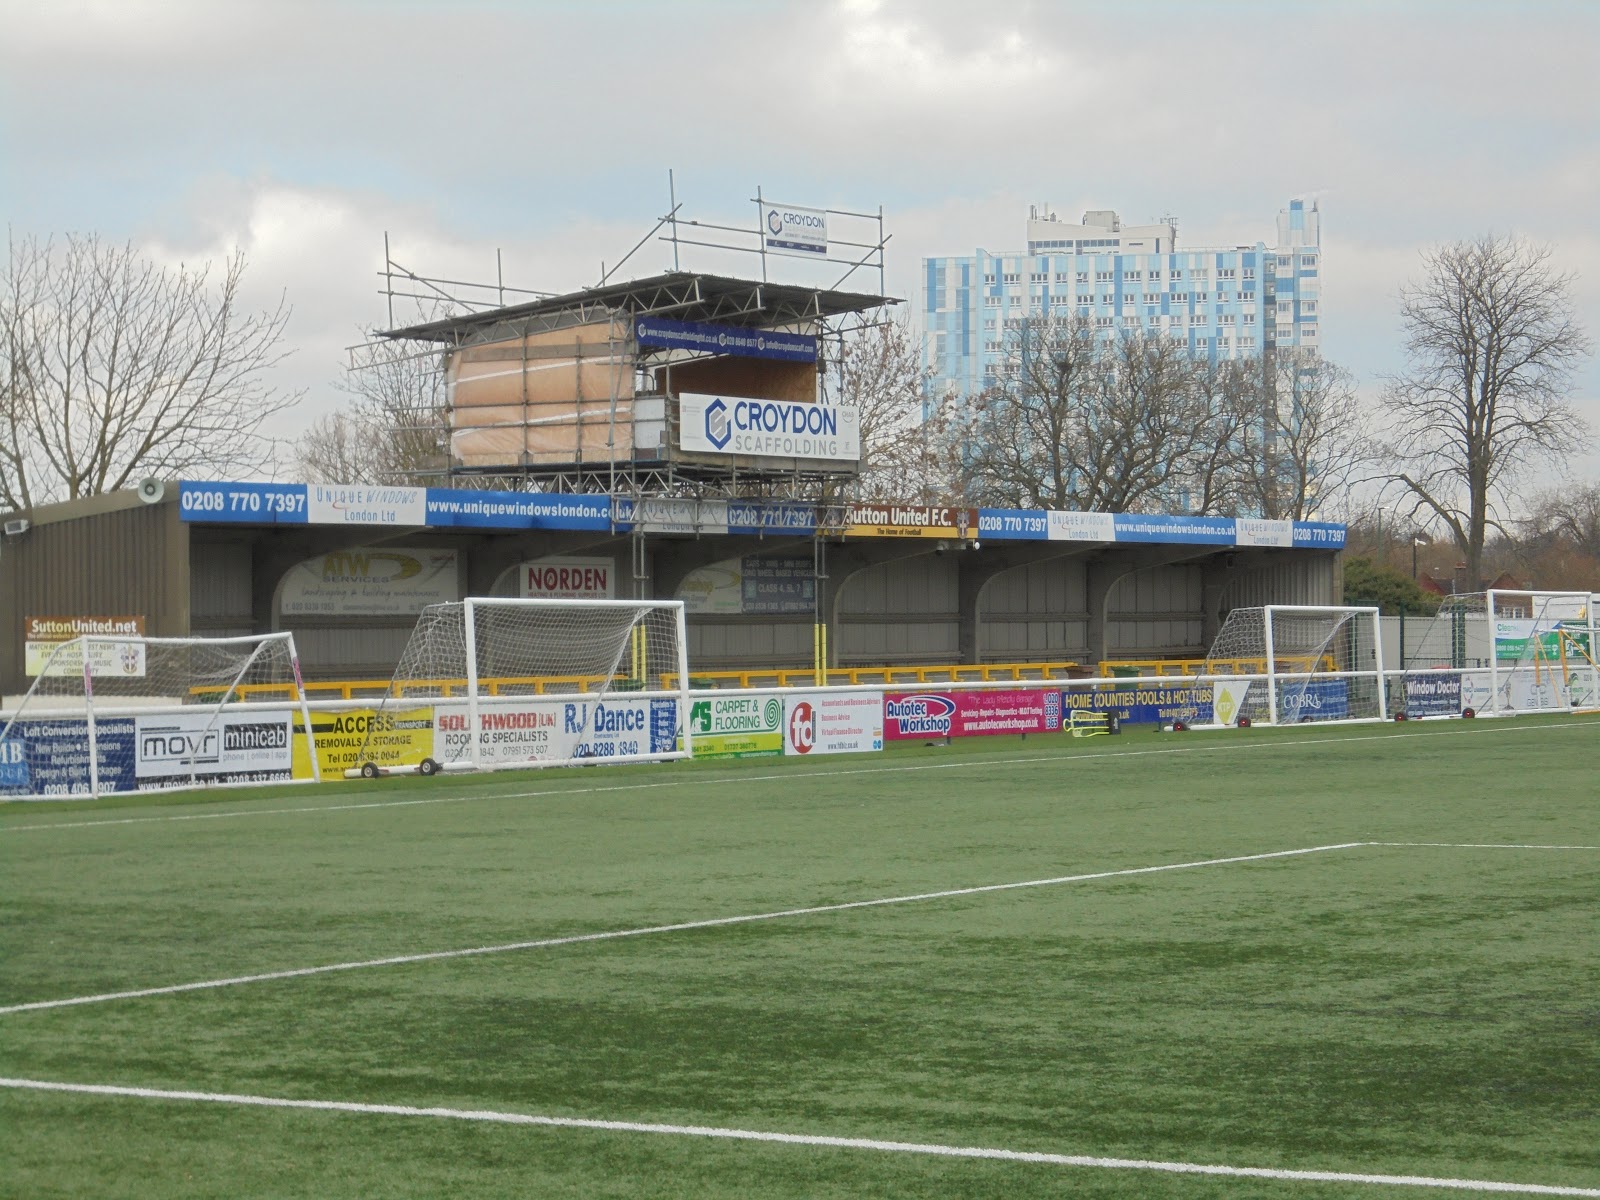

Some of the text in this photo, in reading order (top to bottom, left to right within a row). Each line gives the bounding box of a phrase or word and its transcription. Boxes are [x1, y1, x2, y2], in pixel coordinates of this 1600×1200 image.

[783, 213, 825, 229] CROYDON
[734, 400, 837, 436] CROYDON
[735, 434, 837, 456] SCAFFOLDING
[181, 491, 306, 513] 0208 770 7397
[316, 486, 418, 504] UNIQUE WINDOWS
[344, 509, 396, 523] London Ltd
[427, 500, 632, 521] www.uniquewindowslondon.couk
[729, 509, 757, 525] 0208
[890, 506, 930, 526] United
[931, 508, 952, 527] F.C.
[885, 528, 899, 536] Home
[899, 528, 905, 536] of
[905, 528, 922, 536] Football
[979, 516, 1047, 533] 0208 770 7397
[1115, 522, 1236, 538] www.uniquewindowslondon.co.uk
[1293, 528, 1346, 542] 0208 770 7397
[322, 576, 390, 584] SERVICES
[528, 567, 607, 591] NORDEN
[758, 583, 778, 593] CLASS
[31, 618, 137, 634] SuttonUnited.net
[29, 643, 48, 651] MATCH
[99, 643, 116, 651] NEWS
[93, 659, 112, 667] MUSIC
[1407, 680, 1436, 695] Window
[1437, 680, 1460, 694] Doctor
[886, 692, 1059, 718] Autotec 020
[1065, 688, 1213, 708] HOME COUNTIES POOLS & HOT TUBS
[1283, 694, 1322, 709] COBRA
[715, 699, 759, 714] CARPET &
[996, 707, 1018, 717] Diagnostics
[1044, 705, 1059, 716] 8336
[1158, 709, 1166, 718] Tel
[333, 714, 394, 736] ACCESS
[564, 703, 588, 734] RJ
[594, 702, 645, 733] Dance
[715, 715, 761, 731] FLOORING
[821, 713, 850, 722] Business Advice
[23, 725, 41, 738] Loft
[42, 724, 89, 737] Conversion
[848, 727, 863, 735] Director
[899, 716, 951, 735] Workshop
[963, 717, 1038, 731] www.autotecworkshop.co.uk
[225, 726, 286, 748] minicab
[314, 735, 412, 749] REMOVALS STORAGE
[492, 730, 548, 744] SPECIALISTS
[143, 735, 216, 756] movr
[593, 741, 615, 757] 8288
[223, 749, 287, 762] phone online app
[327, 753, 340, 764] Tel
[342, 752, 357, 763] 020
[35, 768, 60, 779] Design
[44, 783, 69, 796] 0208
[71, 782, 89, 795] 406
